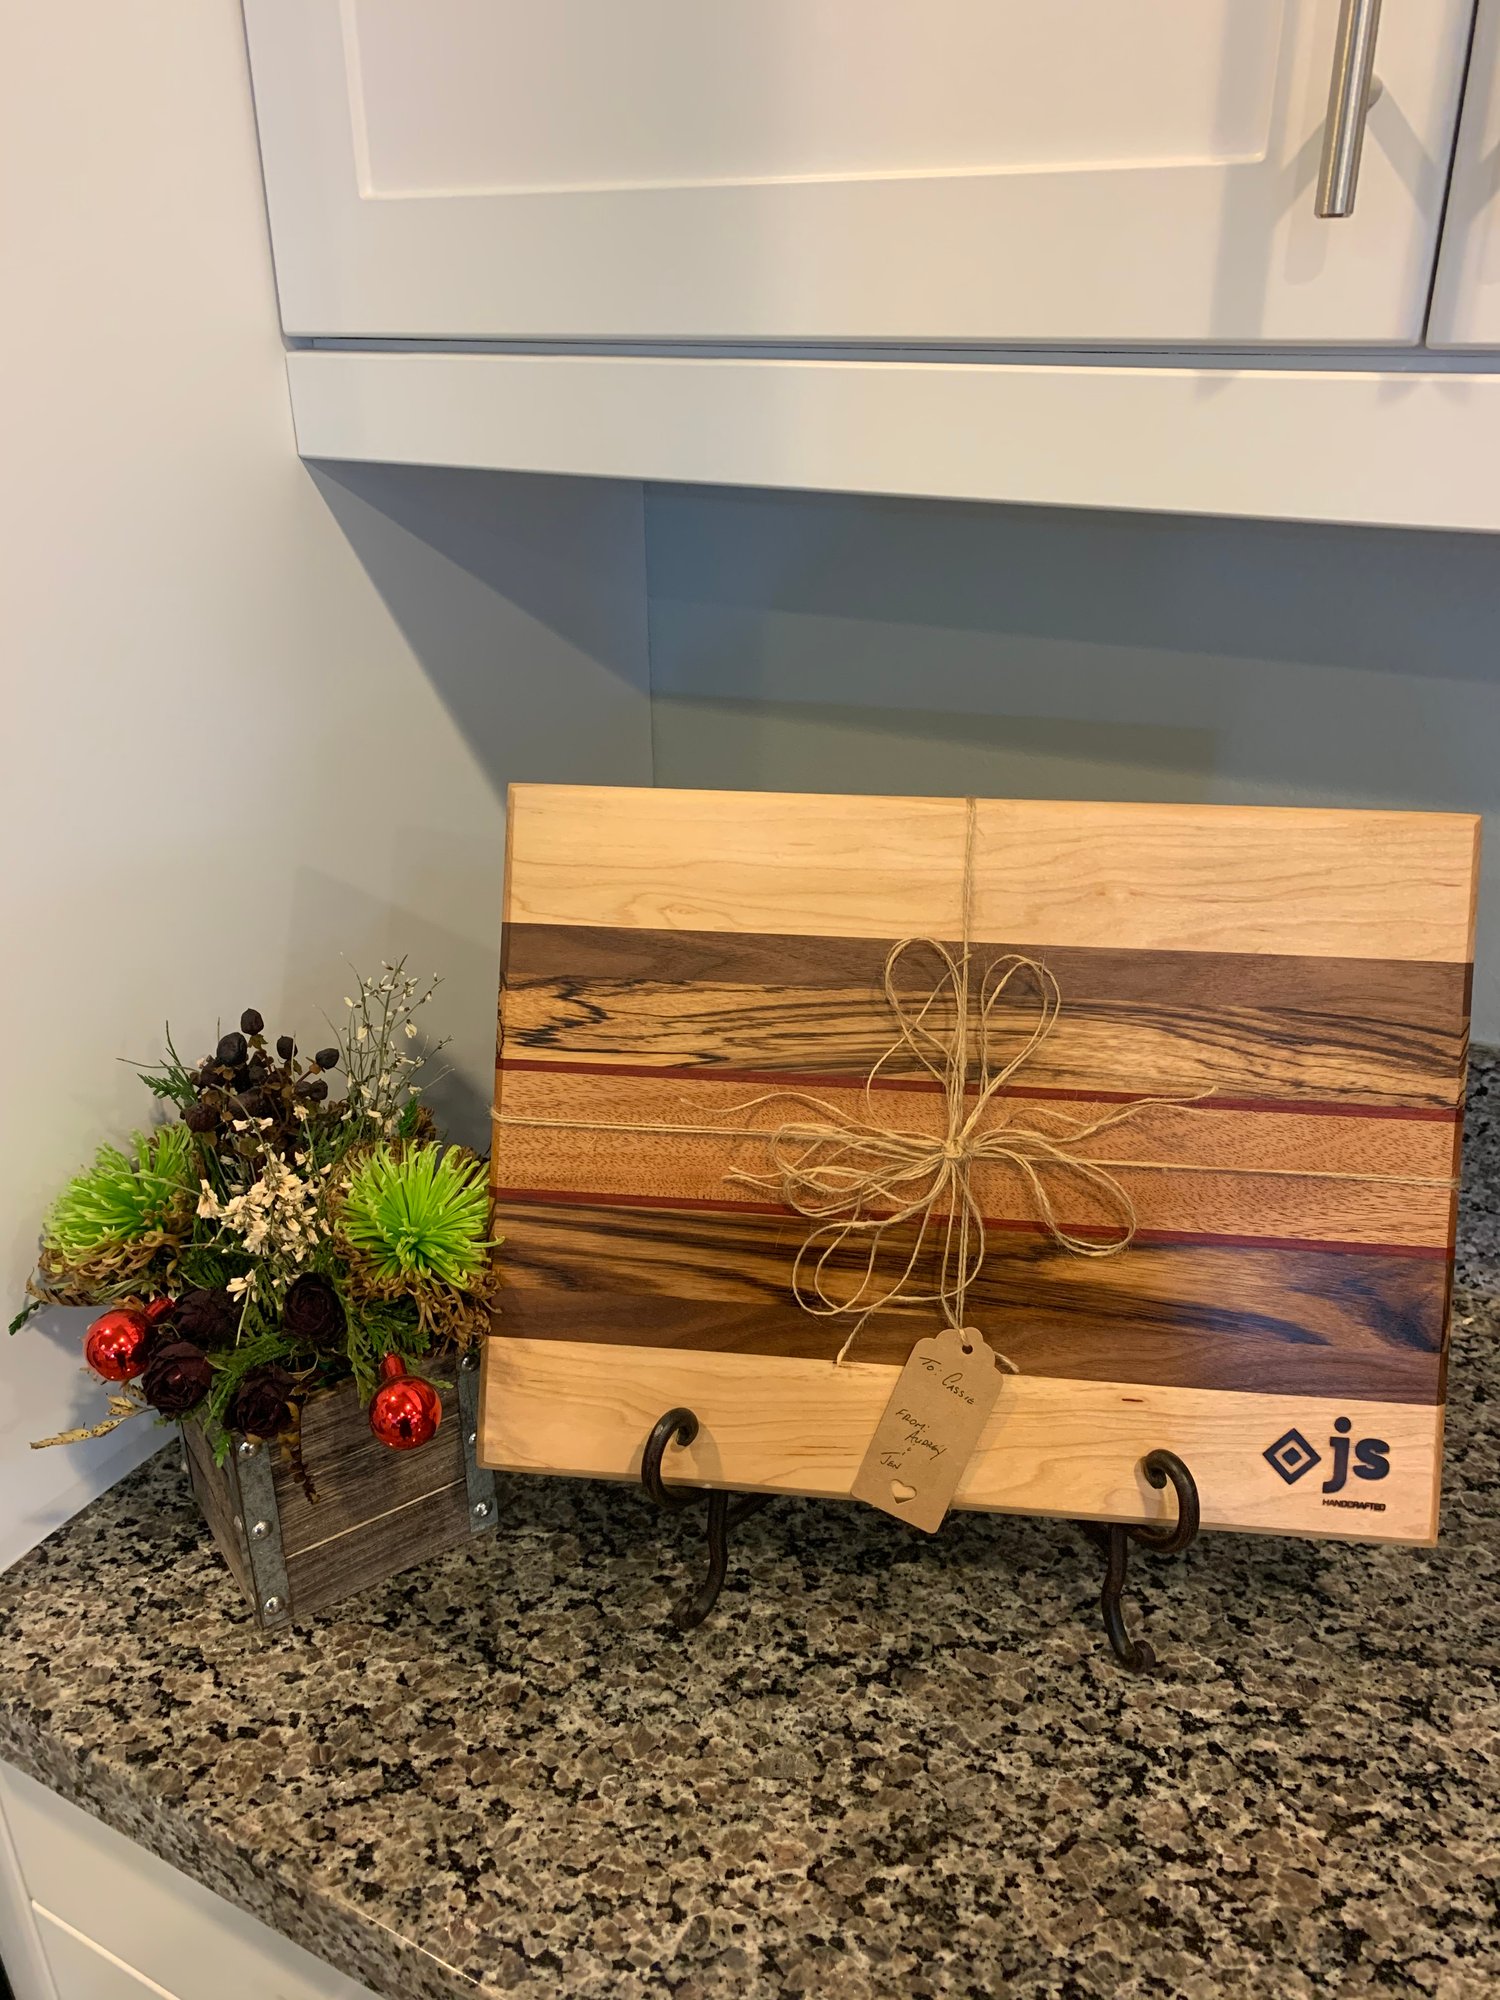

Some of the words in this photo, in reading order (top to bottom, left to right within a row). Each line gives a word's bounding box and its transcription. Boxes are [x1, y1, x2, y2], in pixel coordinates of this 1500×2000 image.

[895, 1408, 930, 1433] FROM:
[1322, 1416, 1390, 1494] js
[1322, 1498, 1386, 1512] HANDCRAFTED
